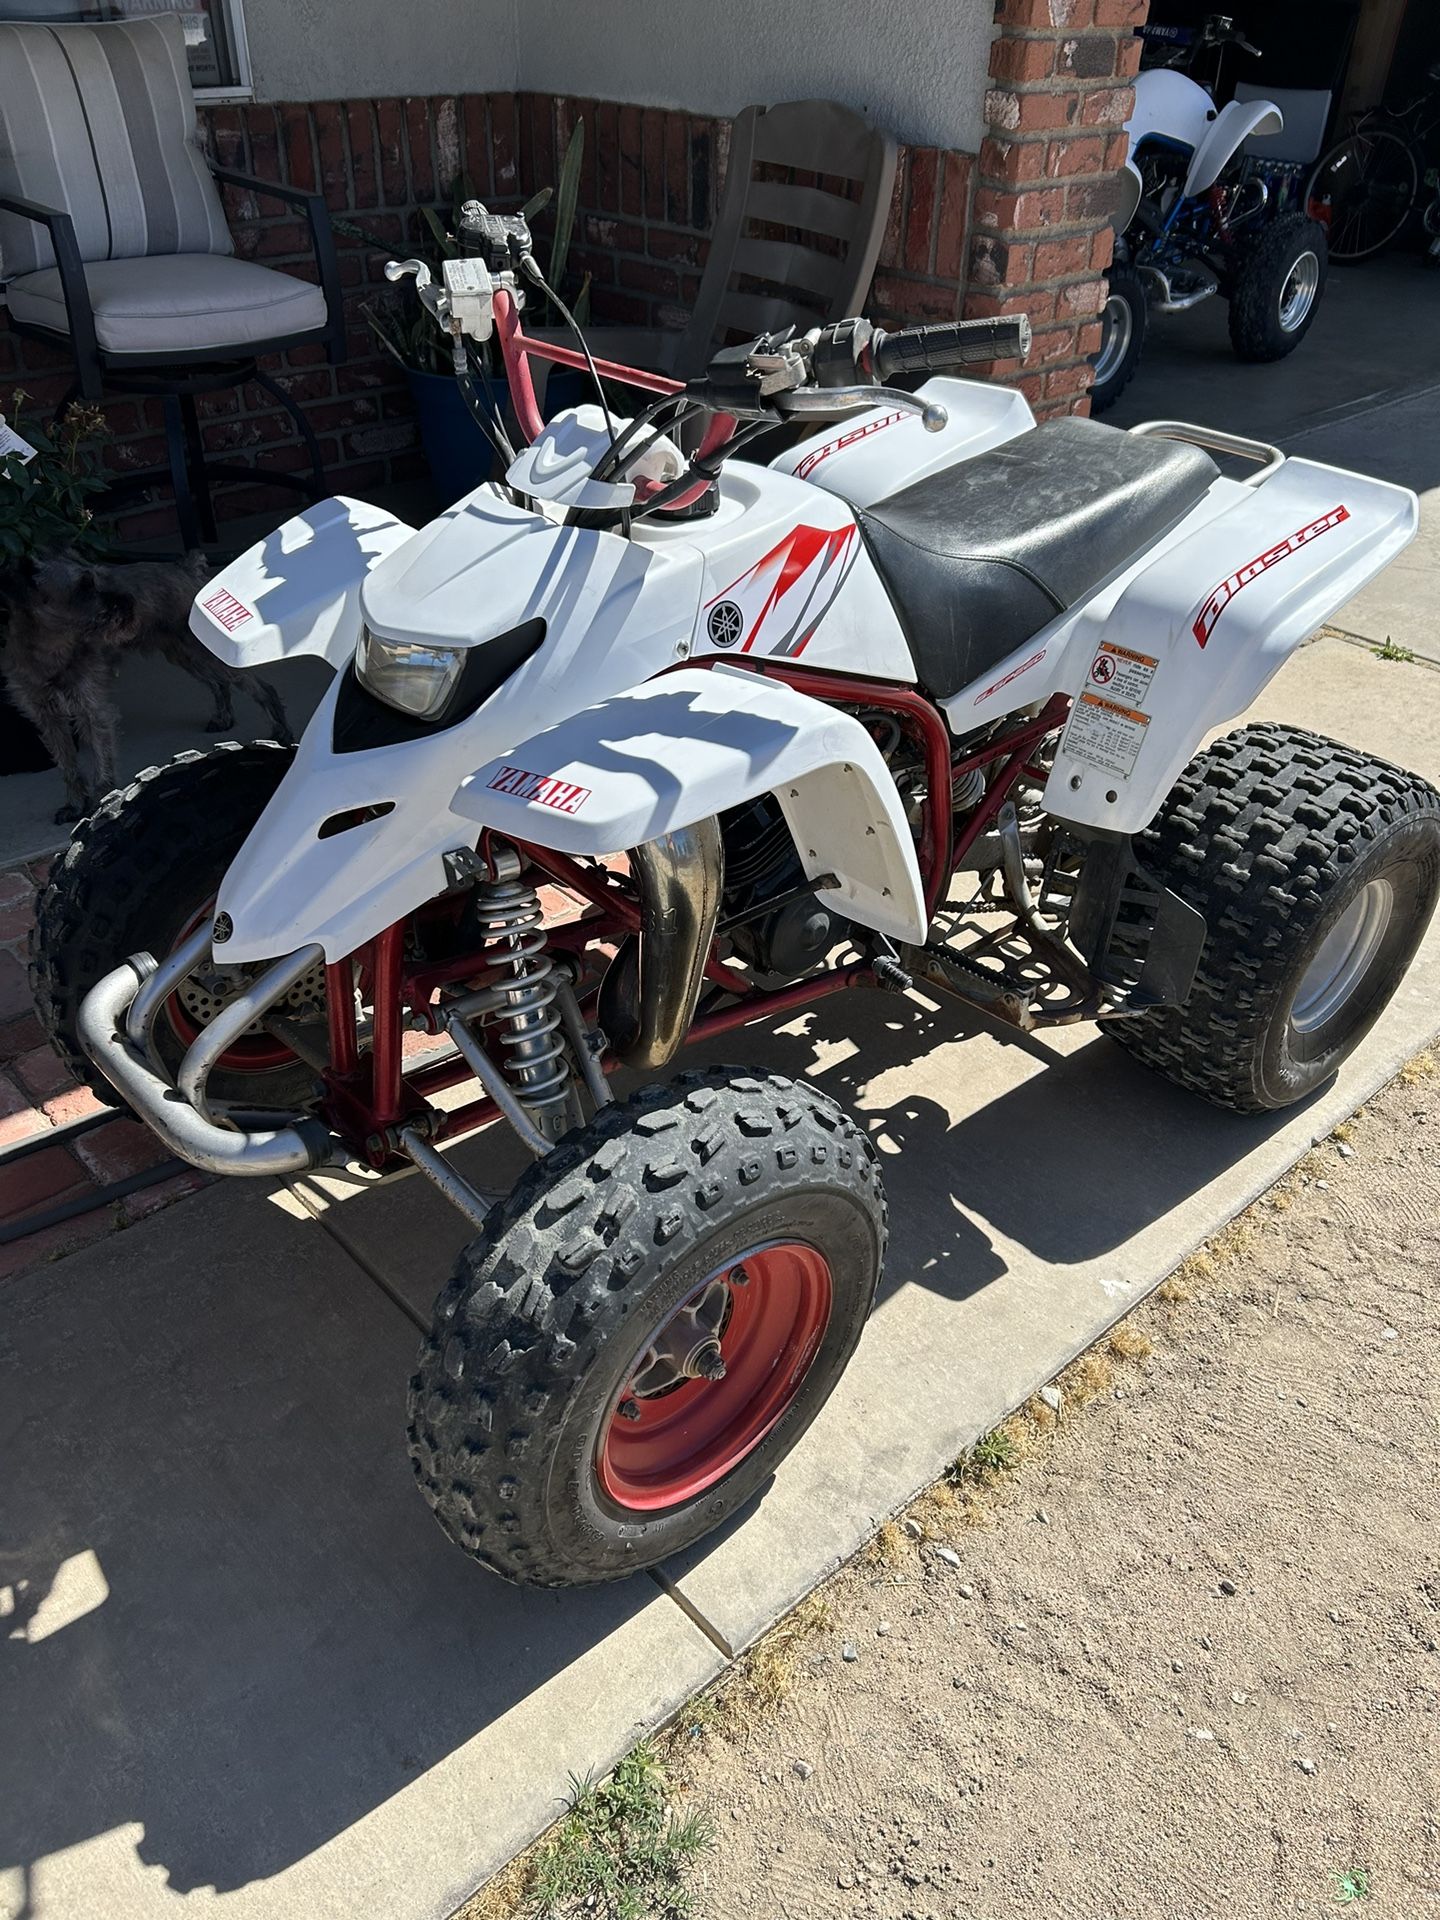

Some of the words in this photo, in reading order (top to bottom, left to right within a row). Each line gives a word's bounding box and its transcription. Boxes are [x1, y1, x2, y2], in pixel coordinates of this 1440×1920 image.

[1195, 507, 1348, 640] Blaster
[203, 588, 253, 631] YAMAHA
[486, 766, 592, 814] YAMAHA
